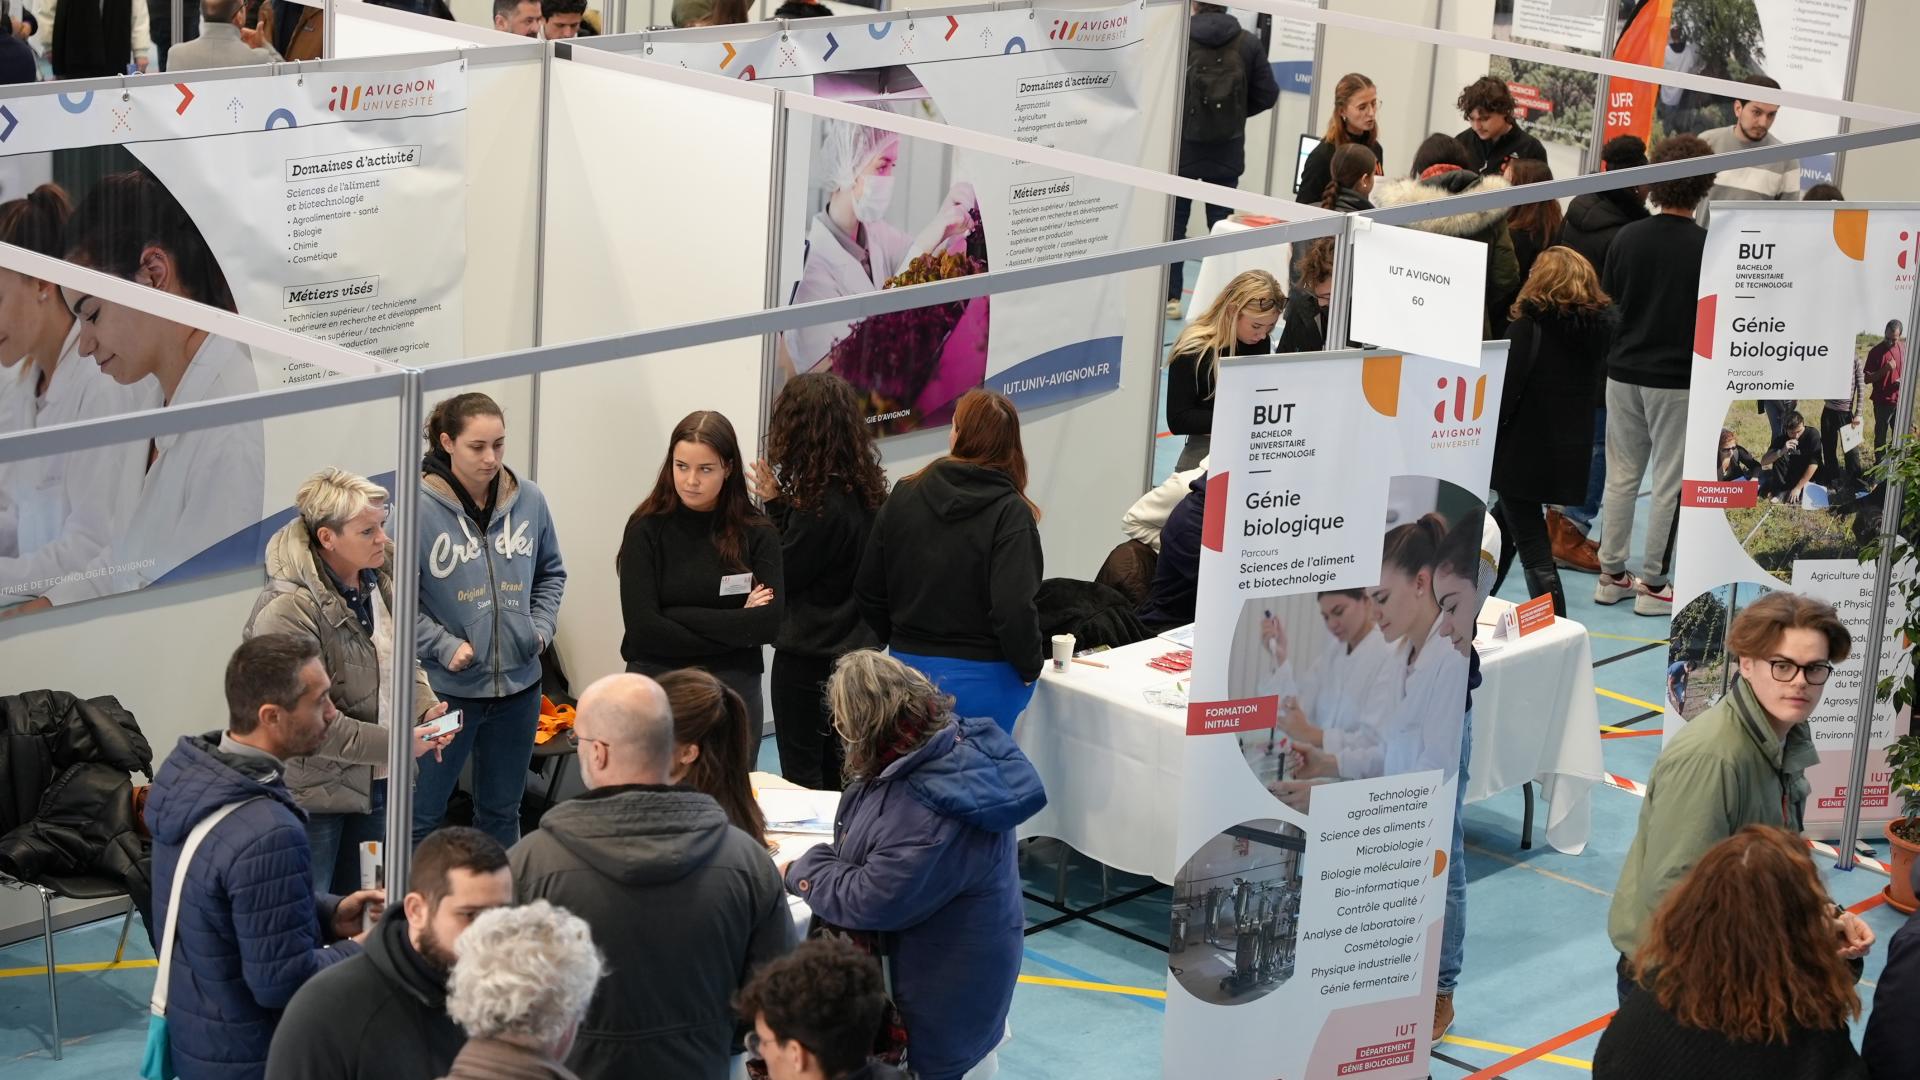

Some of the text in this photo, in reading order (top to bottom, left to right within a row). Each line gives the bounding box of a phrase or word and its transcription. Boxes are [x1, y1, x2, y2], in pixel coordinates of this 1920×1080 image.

[1080, 16, 1128, 30] AVIGNON
[1077, 30, 1126, 42] UNIVERSITÉ
[365, 79, 435, 96] AVIGNON
[1020, 75, 1110, 93] Domaines d'activité
[363, 94, 433, 111] UNIVERSITÉ
[1016, 100, 1050, 112] Agronomie
[1611, 92, 1632, 108] UFR
[1018, 113, 1046, 123] Agriculture
[1608, 112, 1631, 126] STS
[292, 150, 414, 176] Domaines d'activité
[286, 180, 380, 198] Sciences de l'aliment
[1013, 182, 1070, 200] Métiers visés
[286, 194, 364, 212] et biotechnologie
[1012, 206, 1040, 216] Technicien
[1040, 203, 1064, 212] supérieur
[293, 206, 379, 226] Agroalimentaire santé
[1012, 216, 1039, 226] supérieure
[1080, 203, 1118, 215] développement
[293, 228, 322, 238] Biologie
[1011, 227, 1038, 236] Technicien
[1046, 230, 1073, 240] production
[293, 241, 318, 250] Chimie
[1739, 244, 1776, 260] BUT
[293, 251, 338, 264] Cosmétique
[1390, 266, 1450, 286] IUT AVIGNON
[288, 282, 373, 302] Métiers visés
[1412, 296, 1424, 306] 60
[289, 298, 416, 323] Technicien supérieur technicienne
[340, 314, 376, 326] recherche
[378, 313, 386, 321] et
[388, 304, 442, 319] développement
[328, 330, 363, 342] supérieur
[370, 320, 414, 334] technicienne
[1732, 317, 1786, 332] Génie
[400, 342, 430, 354] agricole
[1730, 341, 1828, 362] biologique
[288, 372, 321, 384] Assistant
[1003, 362, 1110, 396] IUT.UNIV-AVIGNON.FR
[1728, 368, 1764, 376] Parcours
[1726, 380, 1794, 394] Agronomie
[878, 408, 910, 422] D'AVIGNON
[1253, 404, 1296, 425] BUT
[1251, 430, 1292, 439] BACHELOR
[1432, 427, 1481, 438] AVIGNON
[1250, 440, 1306, 450] UNIVERSITAIRE
[1249, 449, 1316, 461] DE TECHNOLOGIE
[1246, 490, 1301, 510] Génie
[1244, 514, 1344, 537] biologique
[1241, 548, 1279, 558] Parcours
[1240, 554, 1356, 574] Sciences de l'aliment
[31, 580, 42, 590] DE
[45, 568, 104, 586] TECHNOLOGIE
[1238, 570, 1336, 590] et biotechnologie
[1810, 572, 1860, 582] Agriculture
[458, 581, 523, 600] Original Brand
[477, 600, 492, 610] Since
[1206, 704, 1258, 717] FORMATION
[1205, 718, 1240, 728] INITIALE
[1871, 772, 1890, 782] IUT
[1369, 787, 1429, 802] Technologie
[1348, 800, 1428, 820] agroalimentaire
[1320, 820, 1426, 842] Science des aliments
[1356, 840, 1424, 856] Microbiologie
[1320, 858, 1422, 880] Biologie moléculaire
[1334, 878, 1420, 898] Bio-informatique
[1336, 896, 1418, 916] Contrôle qualité
[1302, 916, 1416, 942] Analyse de laboratoire
[1344, 934, 1414, 954] Cosmétologie
[1312, 953, 1412, 978] Physique industrielle
[1320, 973, 1410, 995] Génie fermentaire
[1396, 1022, 1417, 1037] IUT
[1360, 1042, 1412, 1058] DÉPARTEMENT
[1342, 1055, 1410, 1074] GÉNIE BIOLOGIQUE
